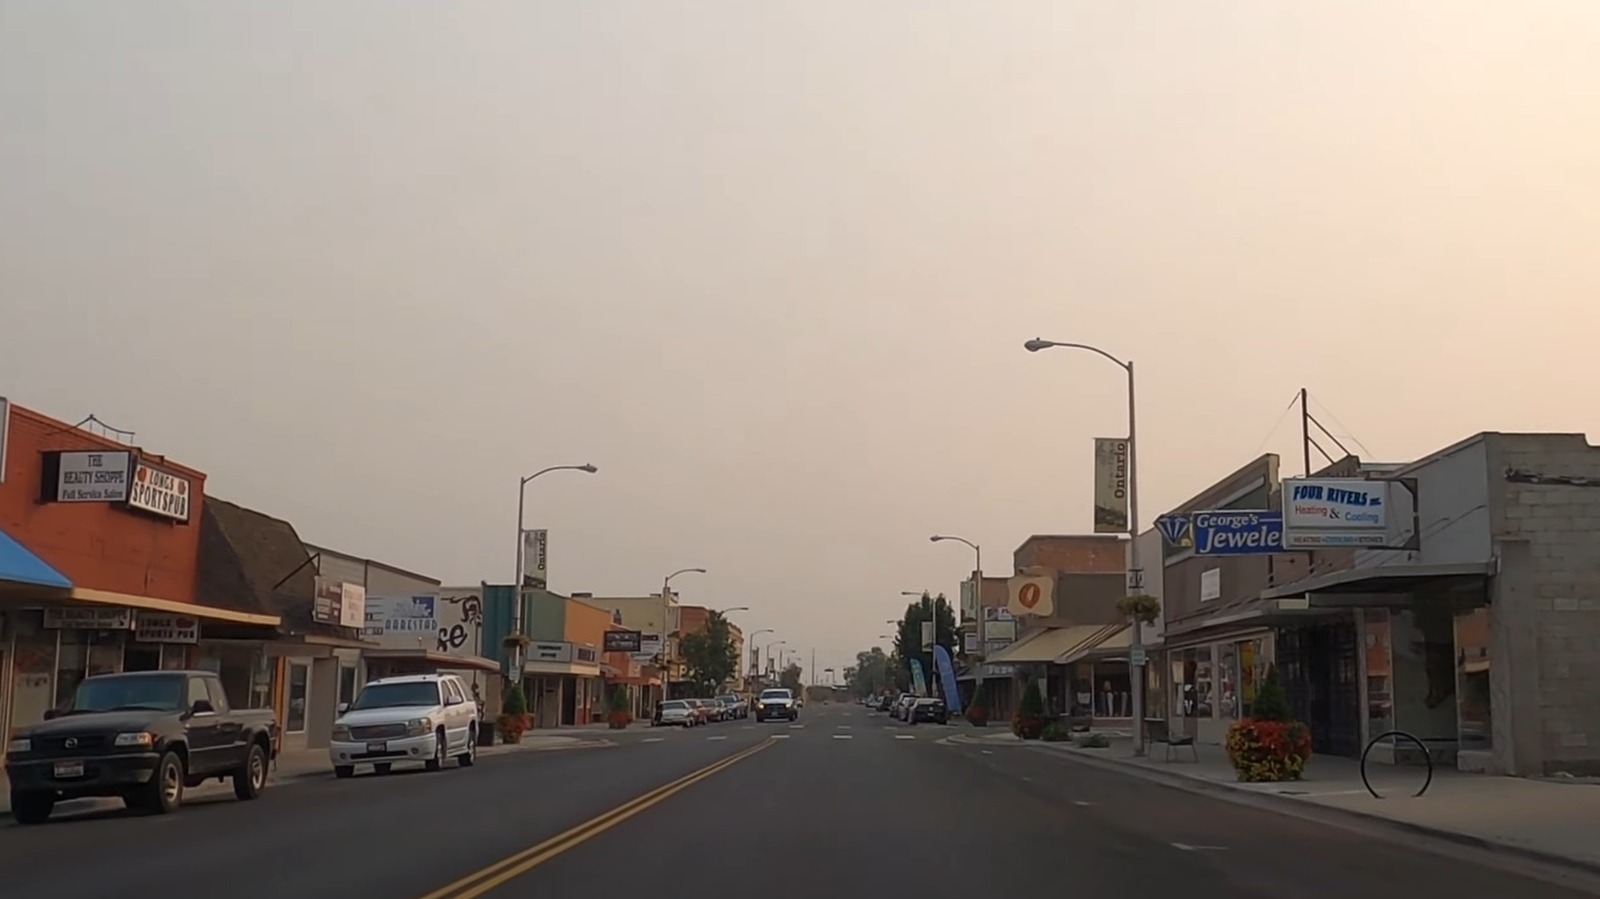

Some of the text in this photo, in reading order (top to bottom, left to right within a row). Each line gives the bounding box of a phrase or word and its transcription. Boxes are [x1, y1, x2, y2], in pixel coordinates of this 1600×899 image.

[64, 471, 93, 484] BEAUTY
[1114, 443, 1125, 499] Ontario
[62, 489, 123, 500] Full Service Salon
[1293, 485, 1323, 501] FOUR
[1326, 487, 1368, 506] RIVERS
[1196, 513, 1259, 529] George's
[1295, 505, 1379, 524] Heating & Cooling
[1199, 525, 1284, 554] Jewele
[537, 532, 546, 571] Ontario
